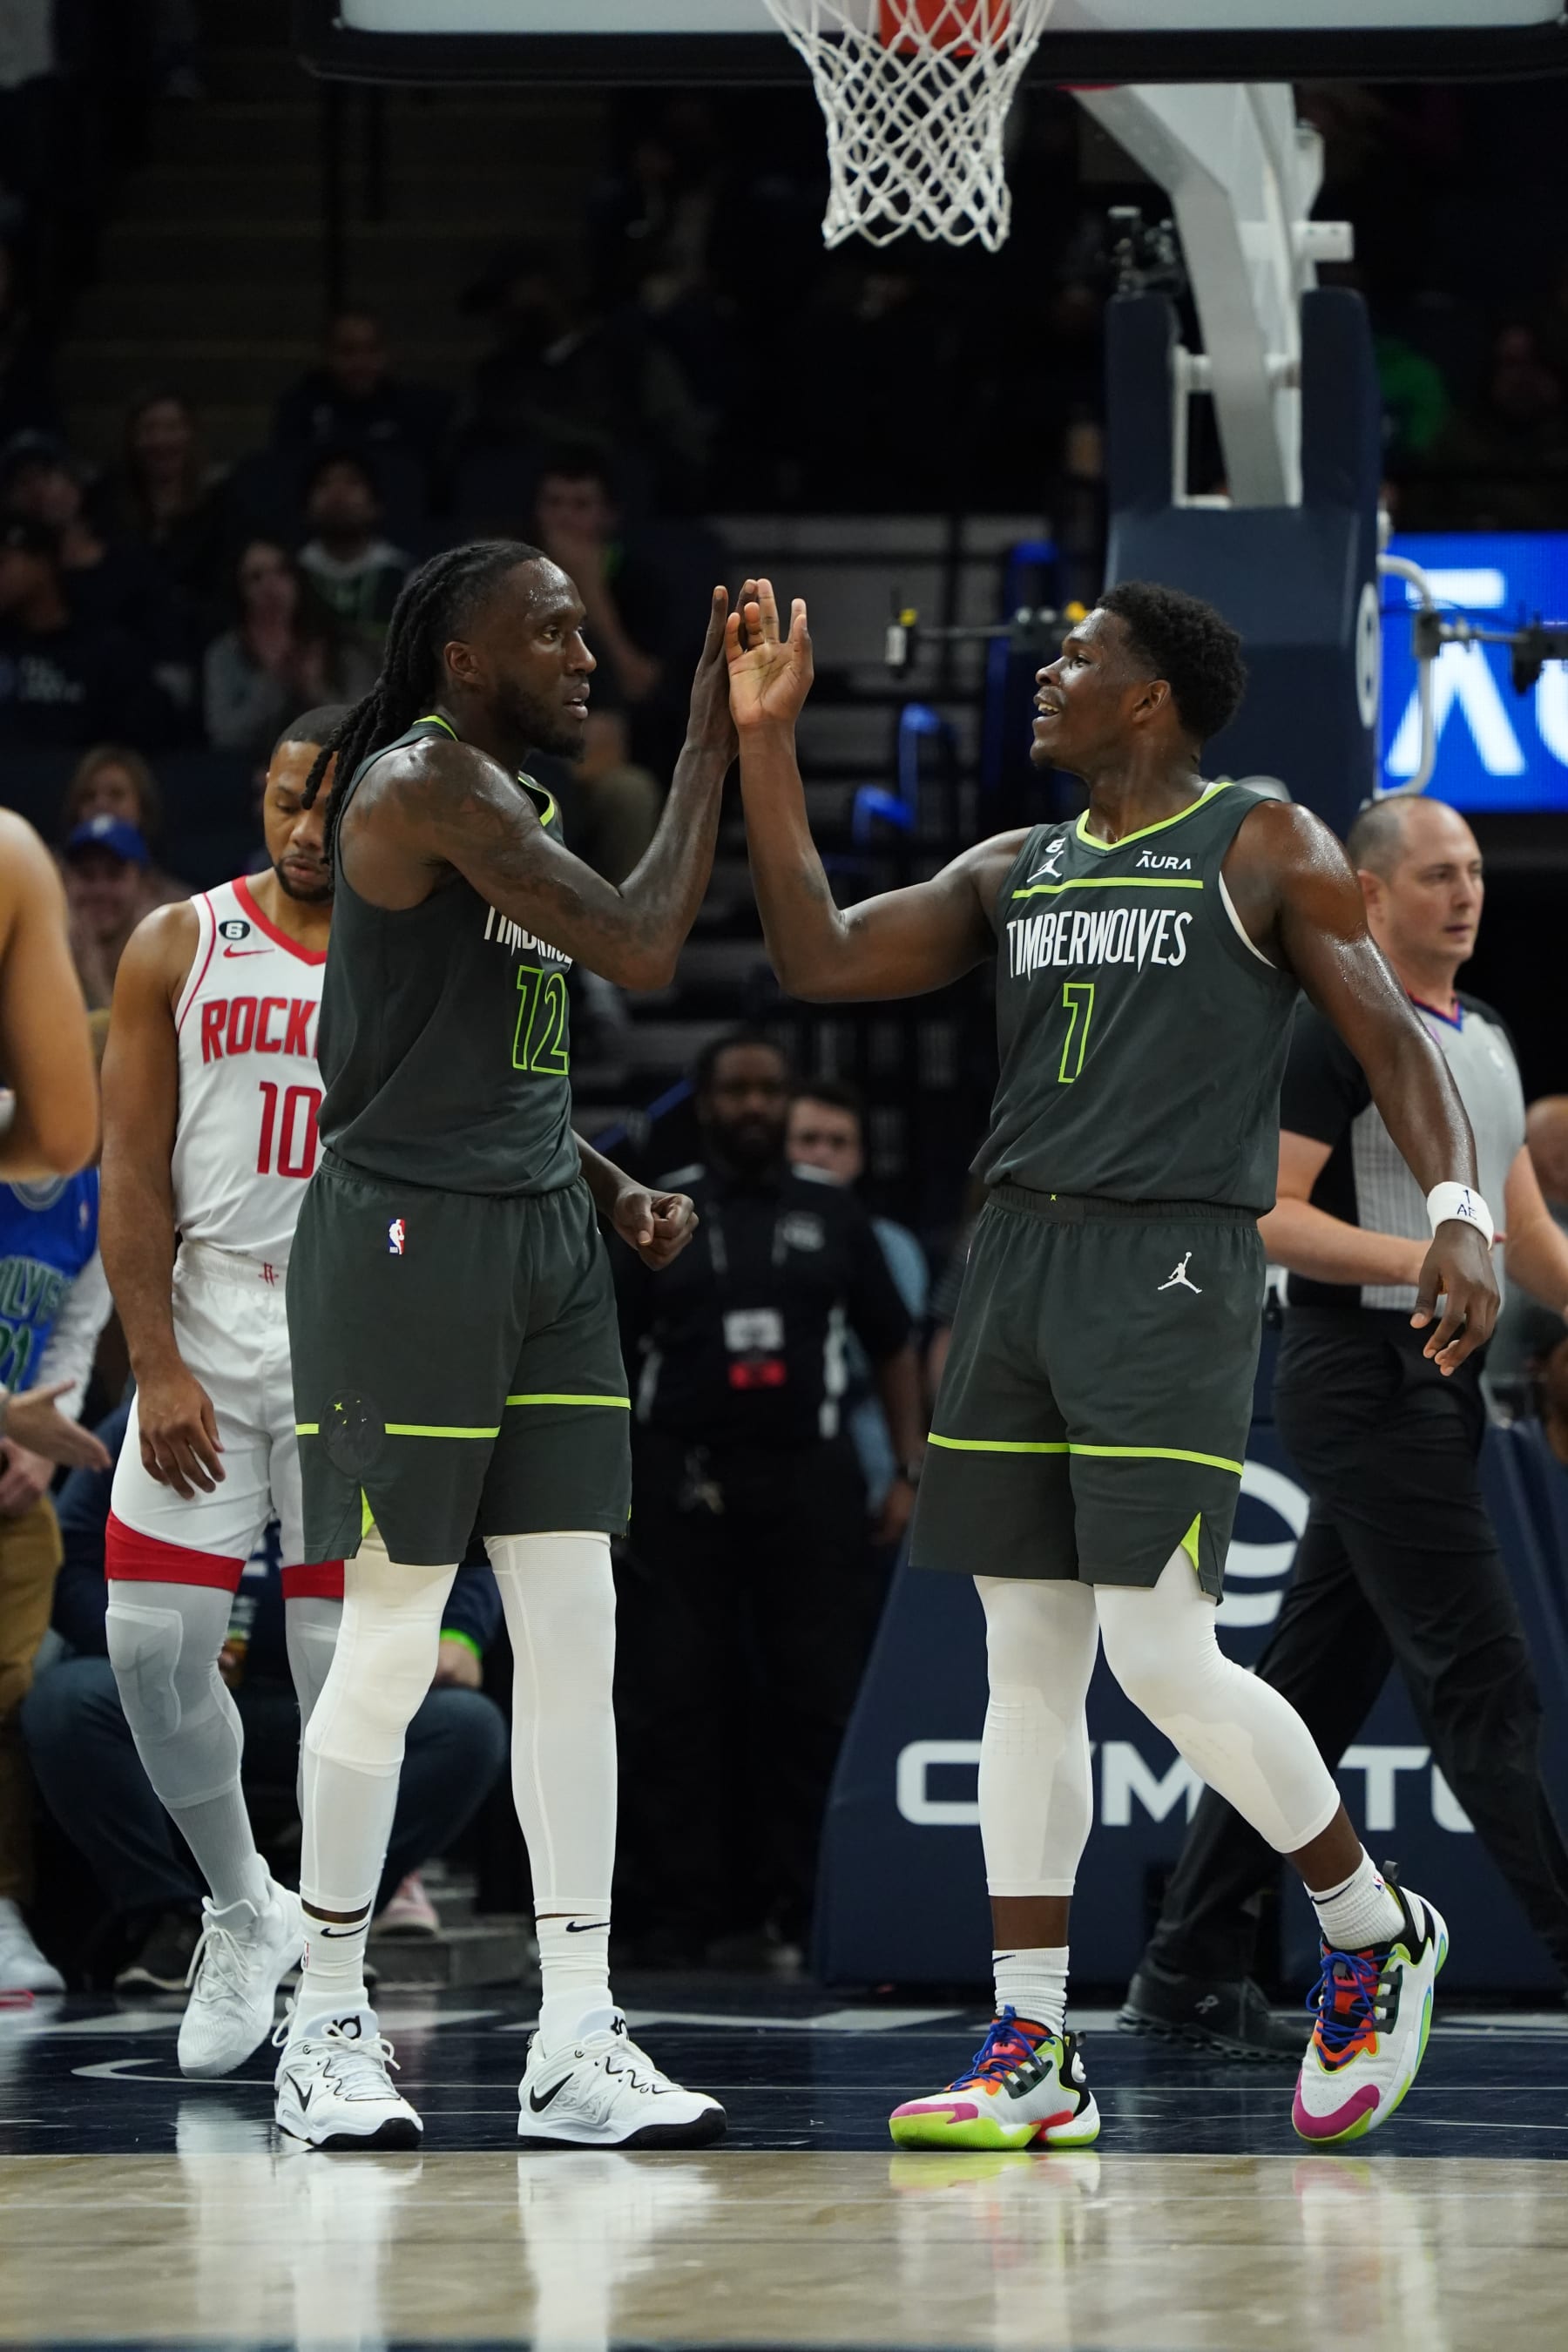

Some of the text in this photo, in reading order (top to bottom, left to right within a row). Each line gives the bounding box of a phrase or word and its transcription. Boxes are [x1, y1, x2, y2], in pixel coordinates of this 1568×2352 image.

[1045, 837, 1066, 854] 6
[225, 921, 245, 940] 6
[1006, 908, 1193, 981] TIMBERWOLVES
[201, 996, 319, 1064] ROCK
[512, 964, 570, 1076] 12
[257, 1081, 322, 1179] 10
